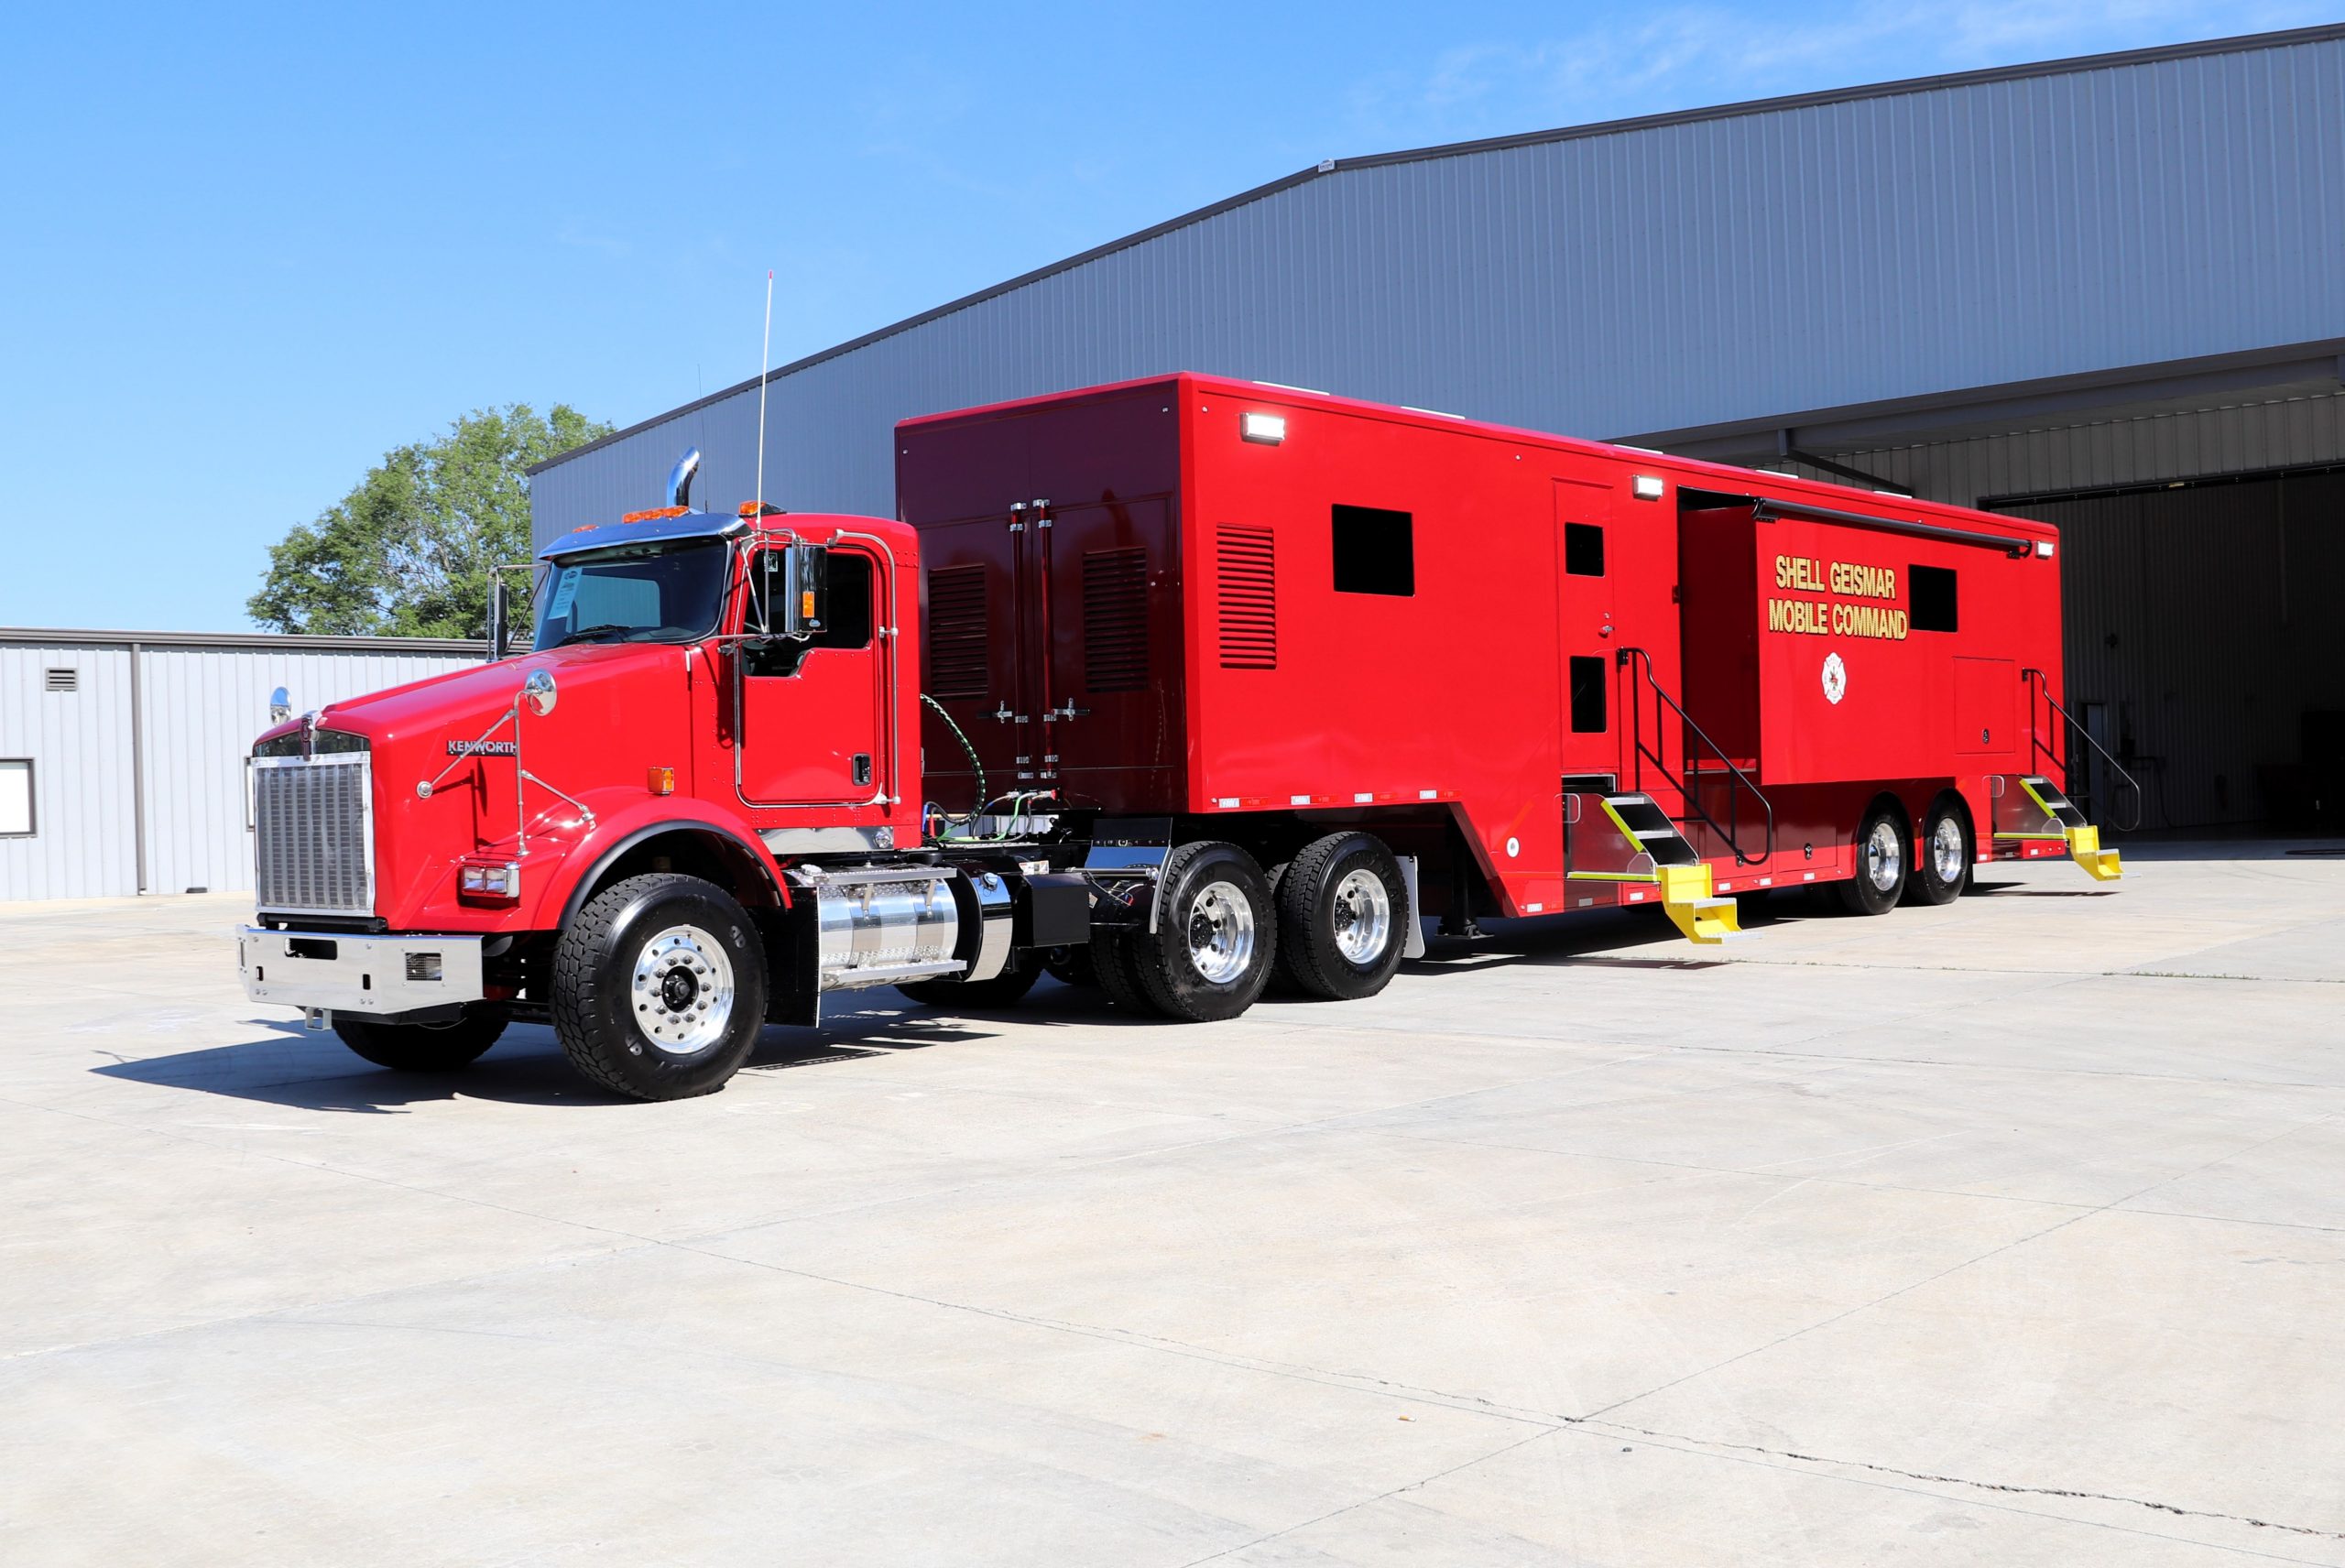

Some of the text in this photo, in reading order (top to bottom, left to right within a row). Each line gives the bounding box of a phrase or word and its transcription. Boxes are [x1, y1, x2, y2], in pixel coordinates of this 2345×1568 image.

[1775, 555, 1896, 599] SHELL GEISMAR
[1768, 599, 1908, 640] MOBILE COMMAND
